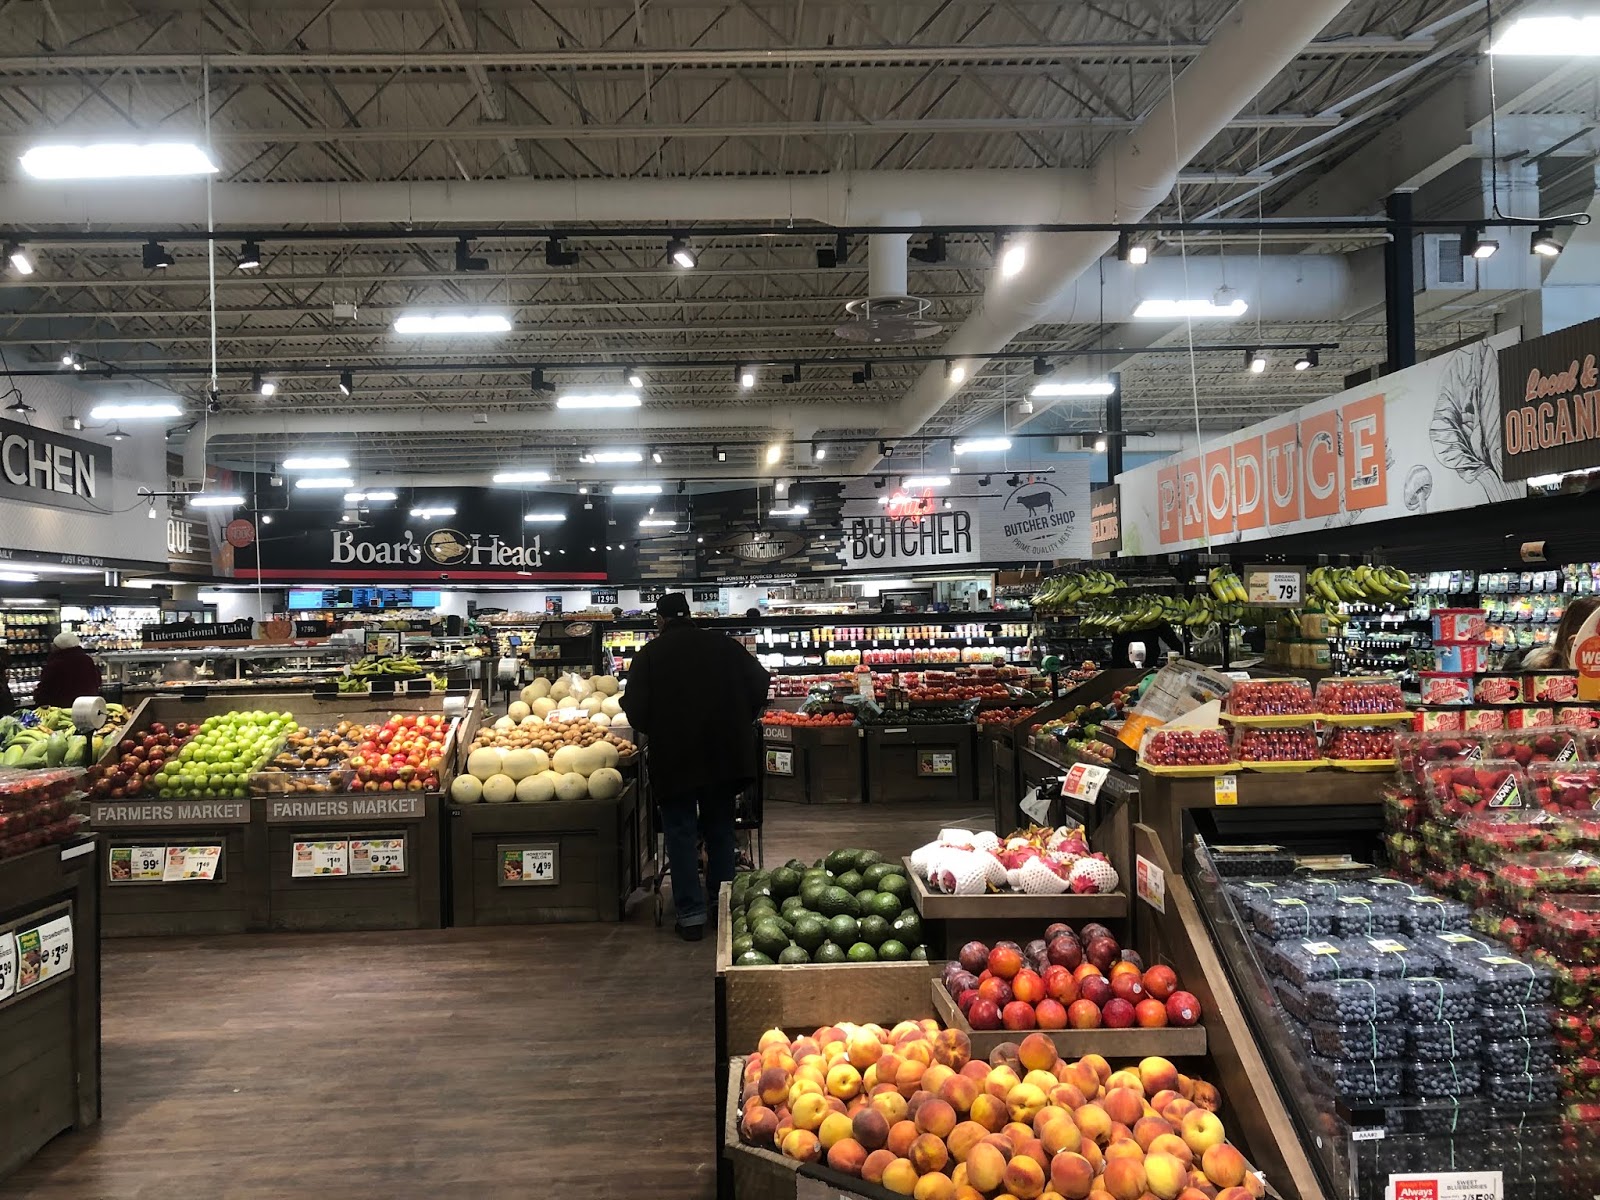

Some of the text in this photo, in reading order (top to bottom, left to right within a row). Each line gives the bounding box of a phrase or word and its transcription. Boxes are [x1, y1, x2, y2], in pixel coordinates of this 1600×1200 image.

[1525, 354, 1599, 402] Local &
[0, 432, 96, 499] CHEN
[1160, 413, 1380, 531] PRODUCE
[167, 519, 193, 553] QUE
[852, 510, 972, 560] BUTCHER
[1003, 516, 1050, 538] BUTCHER
[1049, 510, 1076, 527] SHOP
[330, 529, 543, 568] Boar's Head
[1012, 524, 1075, 555] PRIME QUALITY MEATS
[61, 555, 104, 567] JUST FOR YOU
[150, 622, 250, 642] International Table
[97, 803, 243, 821] FARMERS MARKET
[273, 798, 418, 817] FARMERS MARKET
[143, 859, 159, 870] 99¢
[42, 926, 70, 942] Strawberries
[1401, 1187, 1433, 1197] Always
